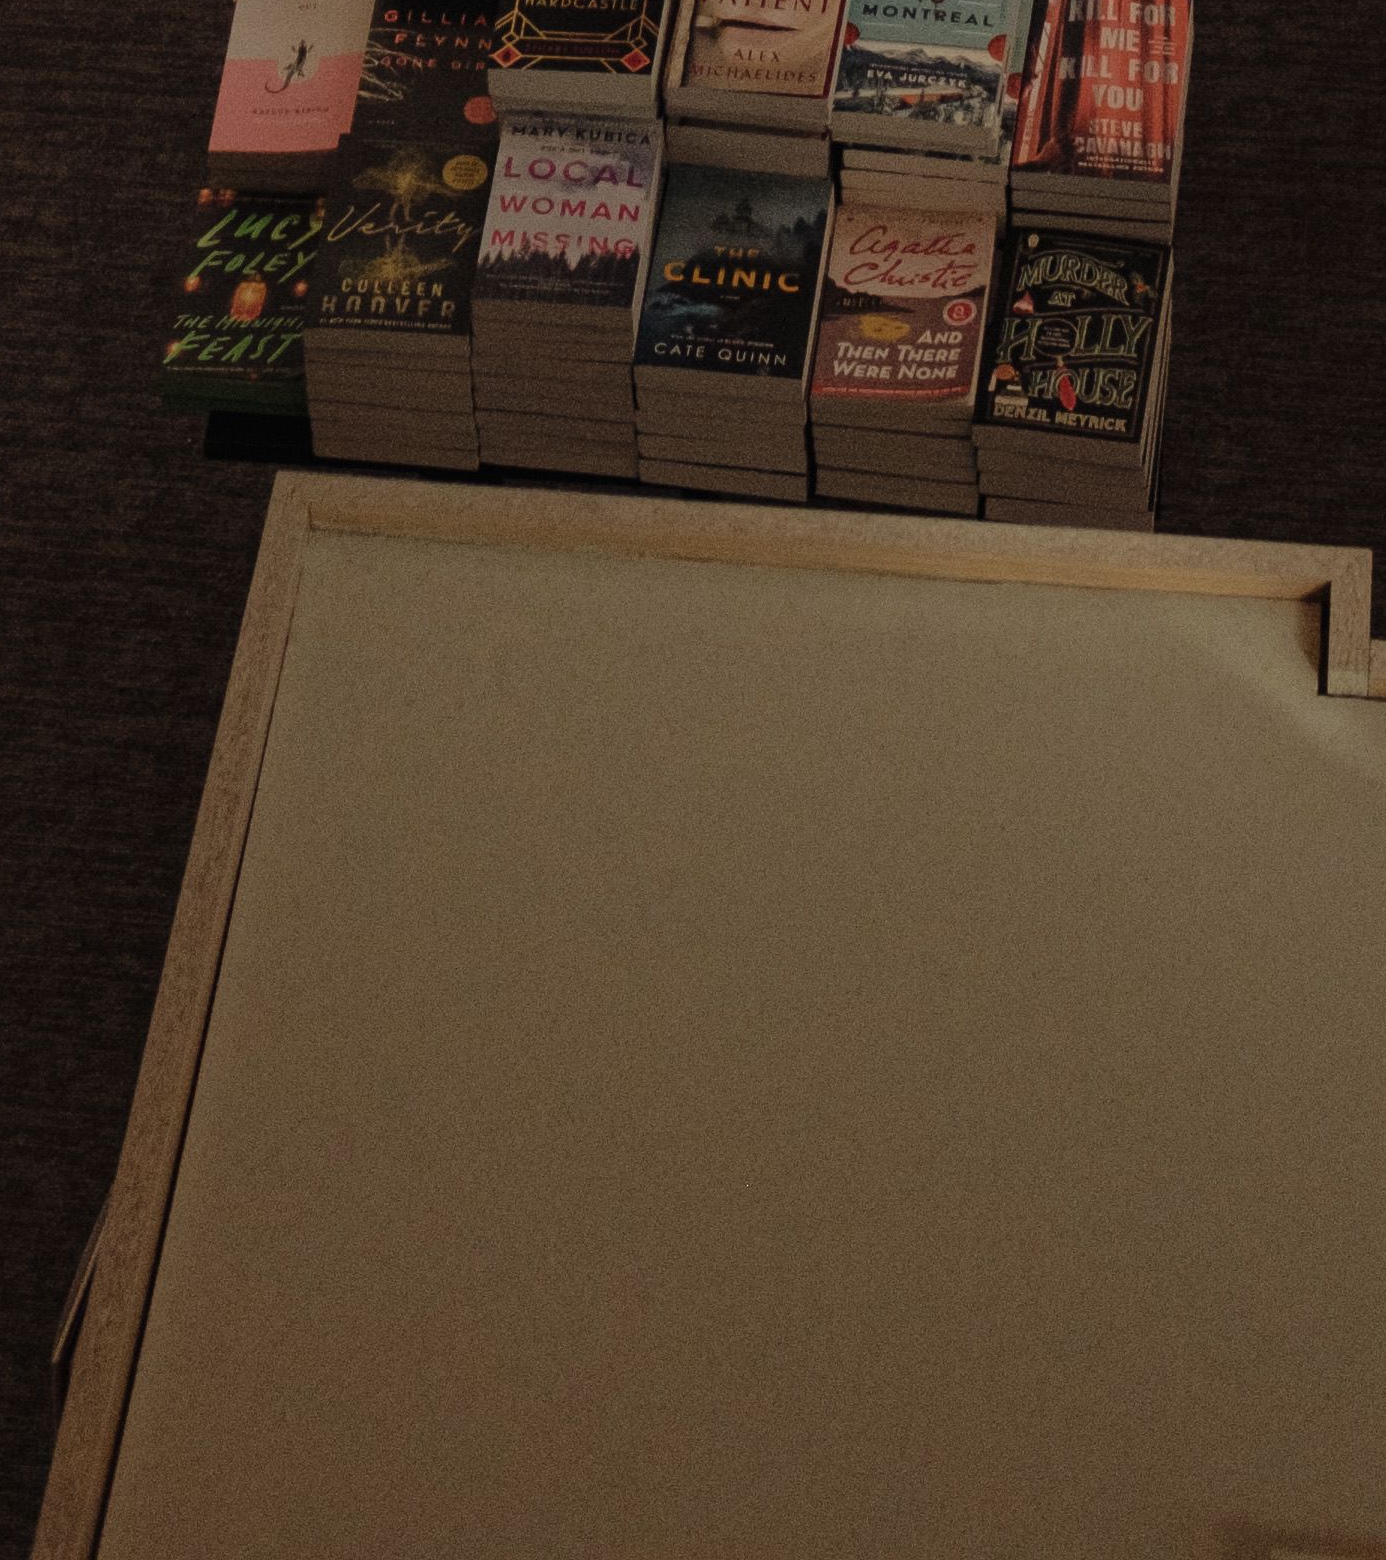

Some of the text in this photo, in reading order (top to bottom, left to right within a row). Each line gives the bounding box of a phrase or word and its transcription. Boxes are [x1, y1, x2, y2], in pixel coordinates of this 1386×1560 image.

[862, 3, 995, 28] MONTREAL
[503, 156, 646, 189] LOCAL
[498, 194, 642, 222] WOMAN
[491, 227, 637, 261] MISSING
[662, 261, 802, 294] CLINIC
[653, 341, 789, 367] CATE QUINN
